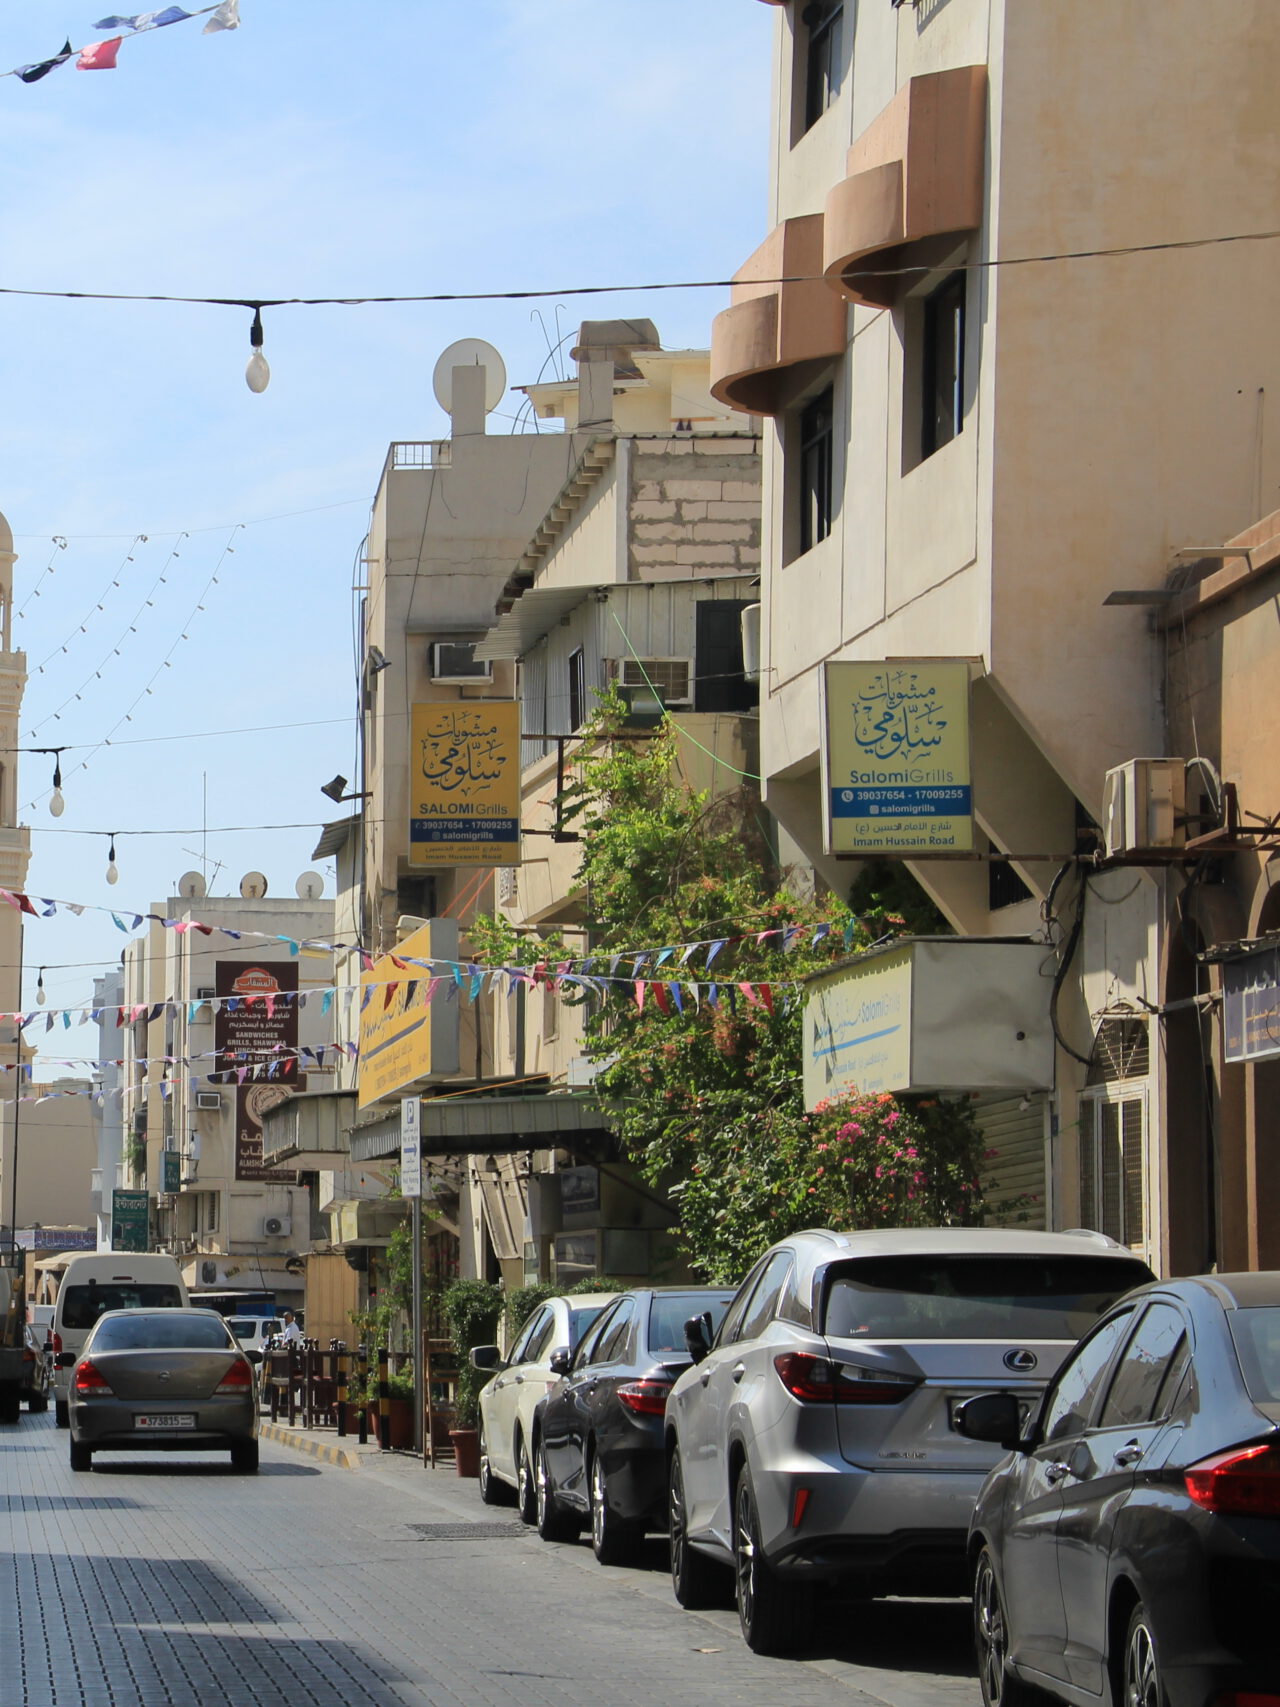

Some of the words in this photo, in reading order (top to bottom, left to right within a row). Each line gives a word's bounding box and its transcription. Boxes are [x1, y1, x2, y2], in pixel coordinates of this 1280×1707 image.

[857, 790, 905, 800] 39037654
[915, 789, 963, 799] 17009255
[881, 804, 935, 814] salomigrills
[422, 821, 463, 829] 39037654
[873, 823, 902, 833] الحسين
[930, 821, 952, 833] شارع
[443, 832, 493, 840] salomigrills
[854, 837, 883, 847] Imam
[886, 836, 927, 846] Hussain
[929, 835, 955, 845] Road
